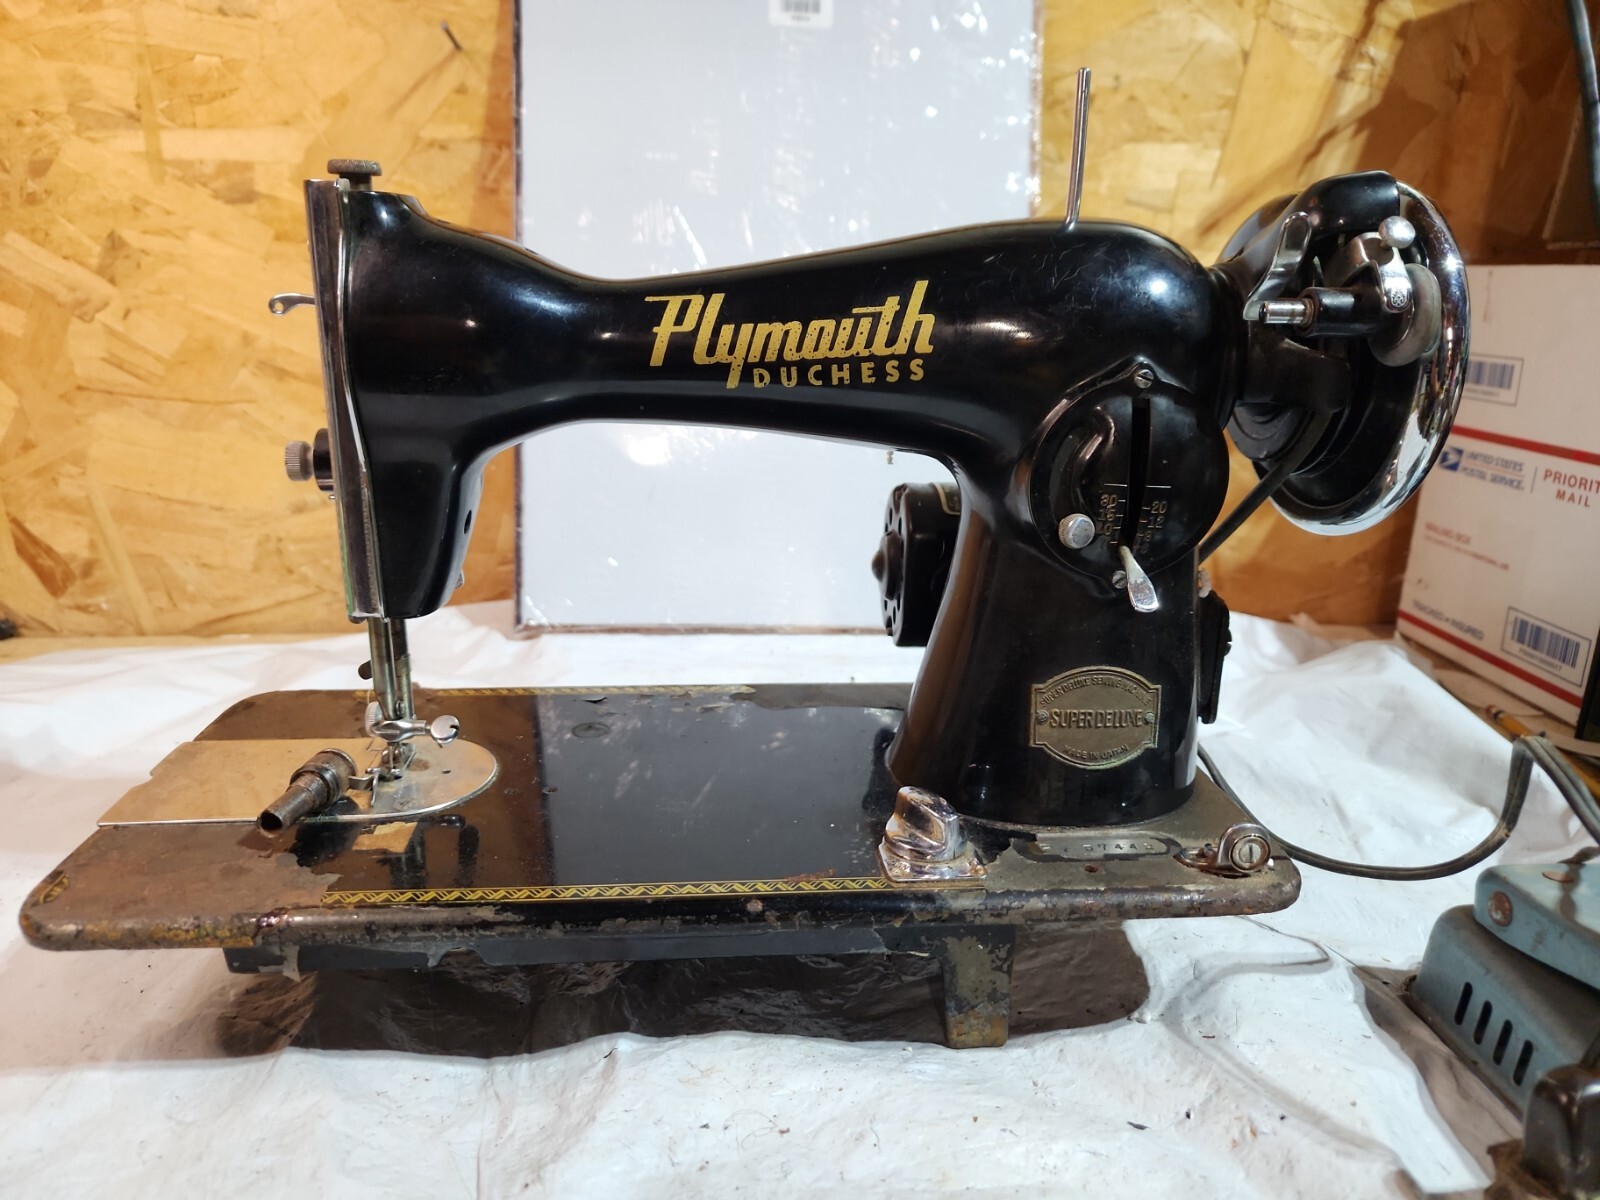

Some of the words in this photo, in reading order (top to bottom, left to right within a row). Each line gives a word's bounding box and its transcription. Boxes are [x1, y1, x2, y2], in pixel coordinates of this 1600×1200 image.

[644, 280, 936, 389] Plymouth
[753, 359, 925, 388] DUCHESS
[1495, 456, 1524, 472] STATES
[1100, 494, 1118, 507] 30
[1151, 501, 1167, 513] 20
[1555, 489, 1590, 508] MAIL
[1148, 516, 1165, 528] 12
[1039, 686, 1065, 707] SUPER
[1062, 677, 1090, 693] DELUXE
[1049, 708, 1093, 729] SUPER
[1094, 708, 1144, 729] DELUXE
[1062, 744, 1088, 760] MADE
[1089, 751, 1099, 760] IN
[1100, 743, 1130, 760] JAPAN
